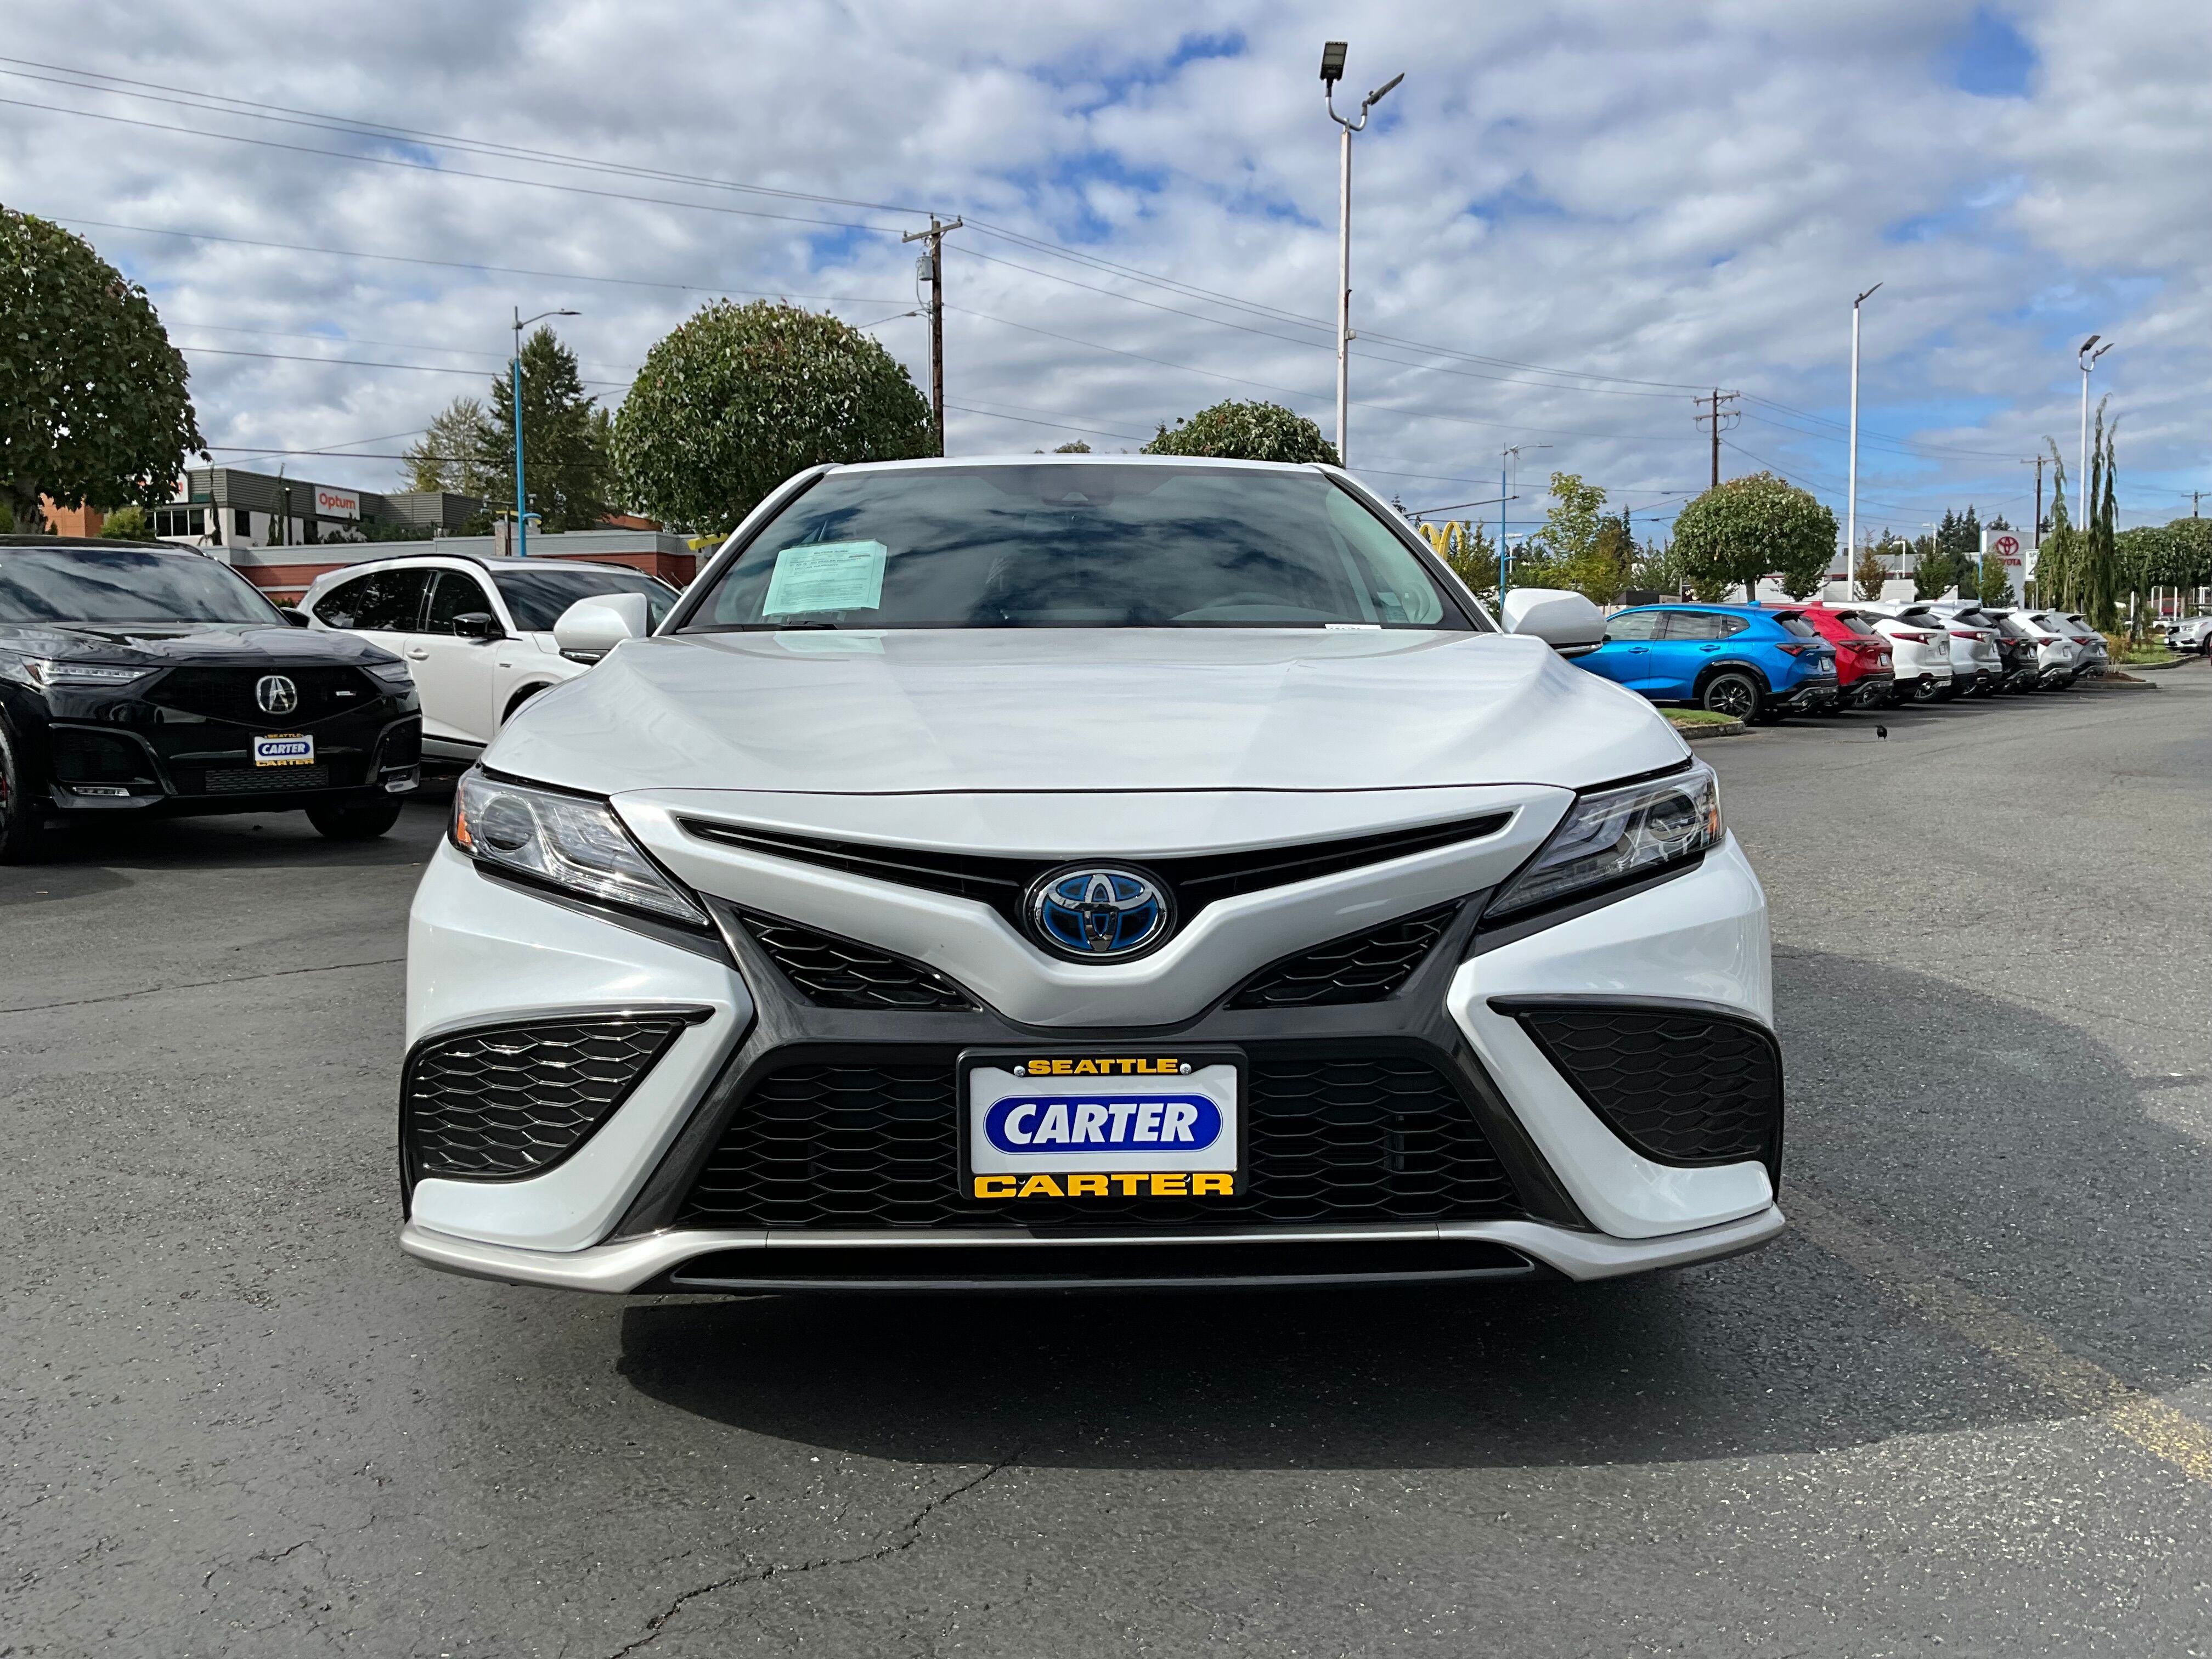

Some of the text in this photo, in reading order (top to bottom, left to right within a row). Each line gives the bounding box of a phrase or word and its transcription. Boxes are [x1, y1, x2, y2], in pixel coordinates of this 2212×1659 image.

[319, 493, 356, 510] Optum
[262, 743, 306, 754] CARTER
[1028, 1058, 1178, 1075] SEATTLE
[1003, 1103, 1198, 1145] CARTER
[974, 1173, 1234, 1199] CARTER
